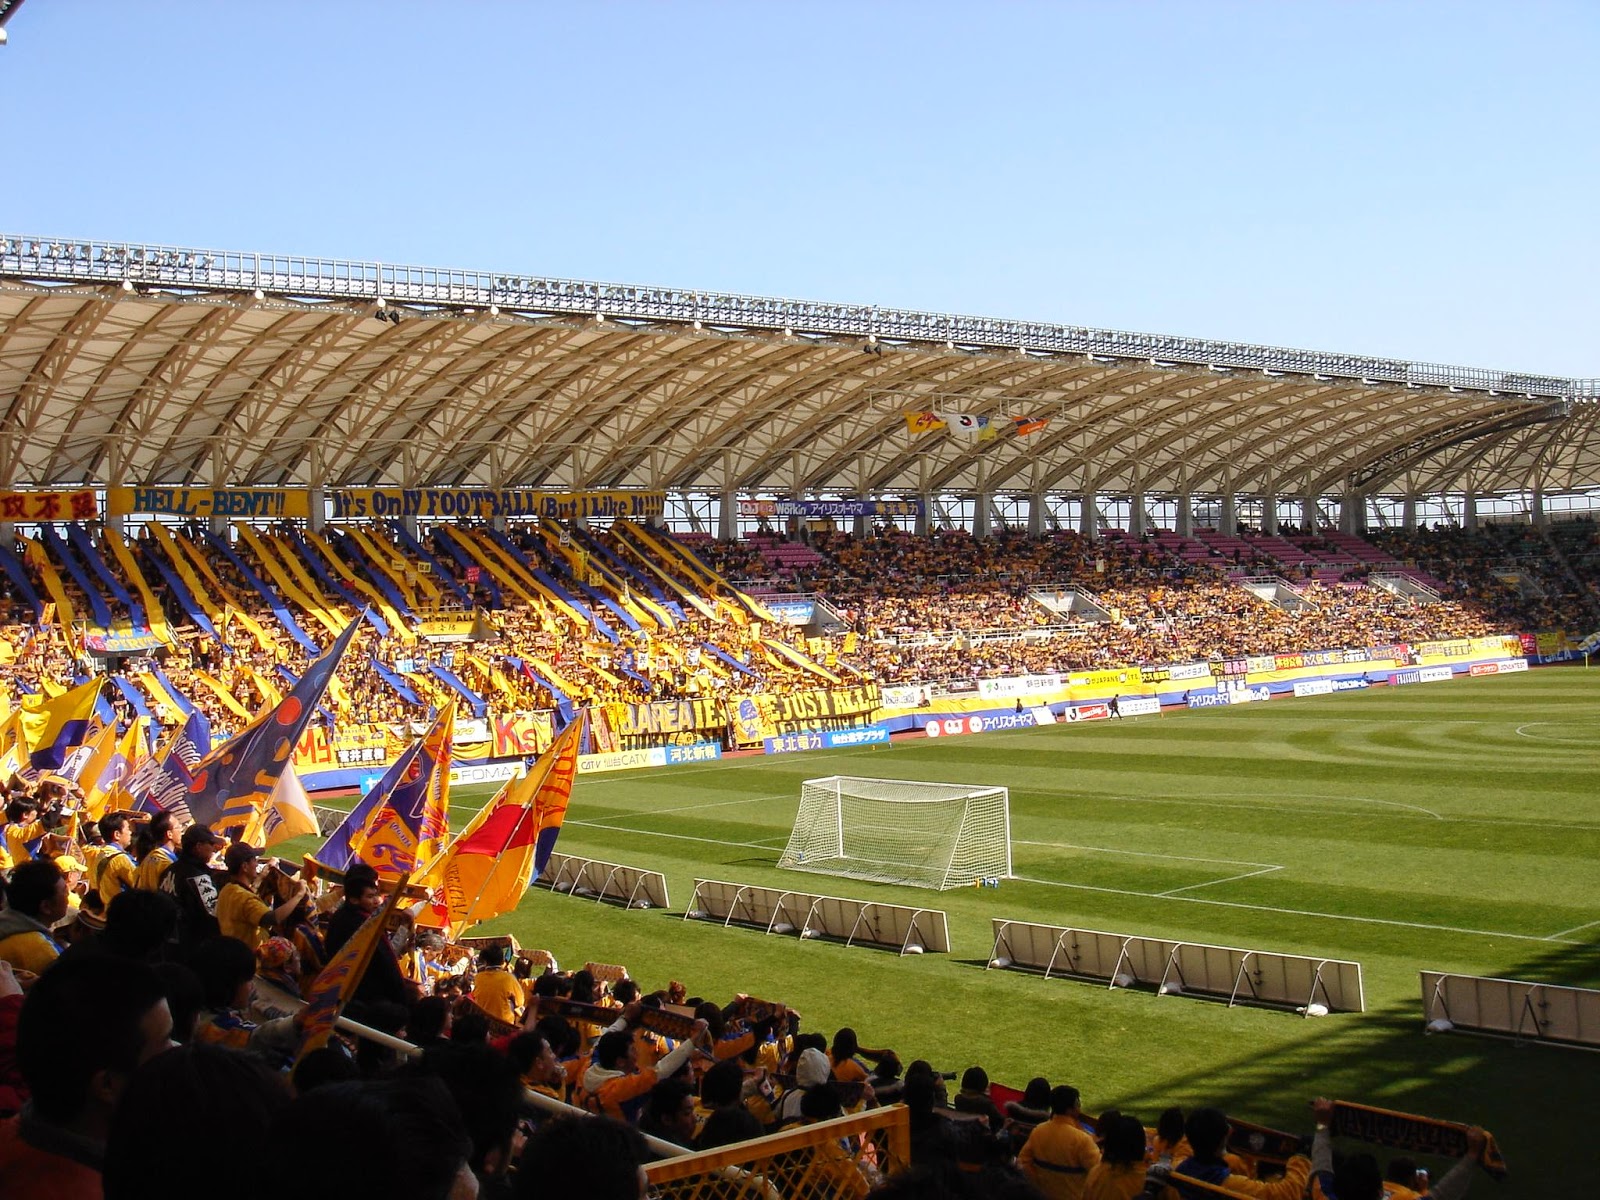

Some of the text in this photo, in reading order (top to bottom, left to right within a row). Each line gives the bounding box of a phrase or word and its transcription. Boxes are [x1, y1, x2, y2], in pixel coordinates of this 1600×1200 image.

[332, 490, 366, 517] It's
[426, 490, 538, 516] FOOTBALL
[591, 495, 627, 517] Like
[810, 502, 864, 515] アイリスオーヤマ
[782, 690, 830, 720] JUST
[983, 712, 1033, 730] アイリスオーヤマ
[771, 733, 822, 753] 東北電力
[670, 744, 717, 762] 河北新報
[461, 766, 512, 781] FOMA
